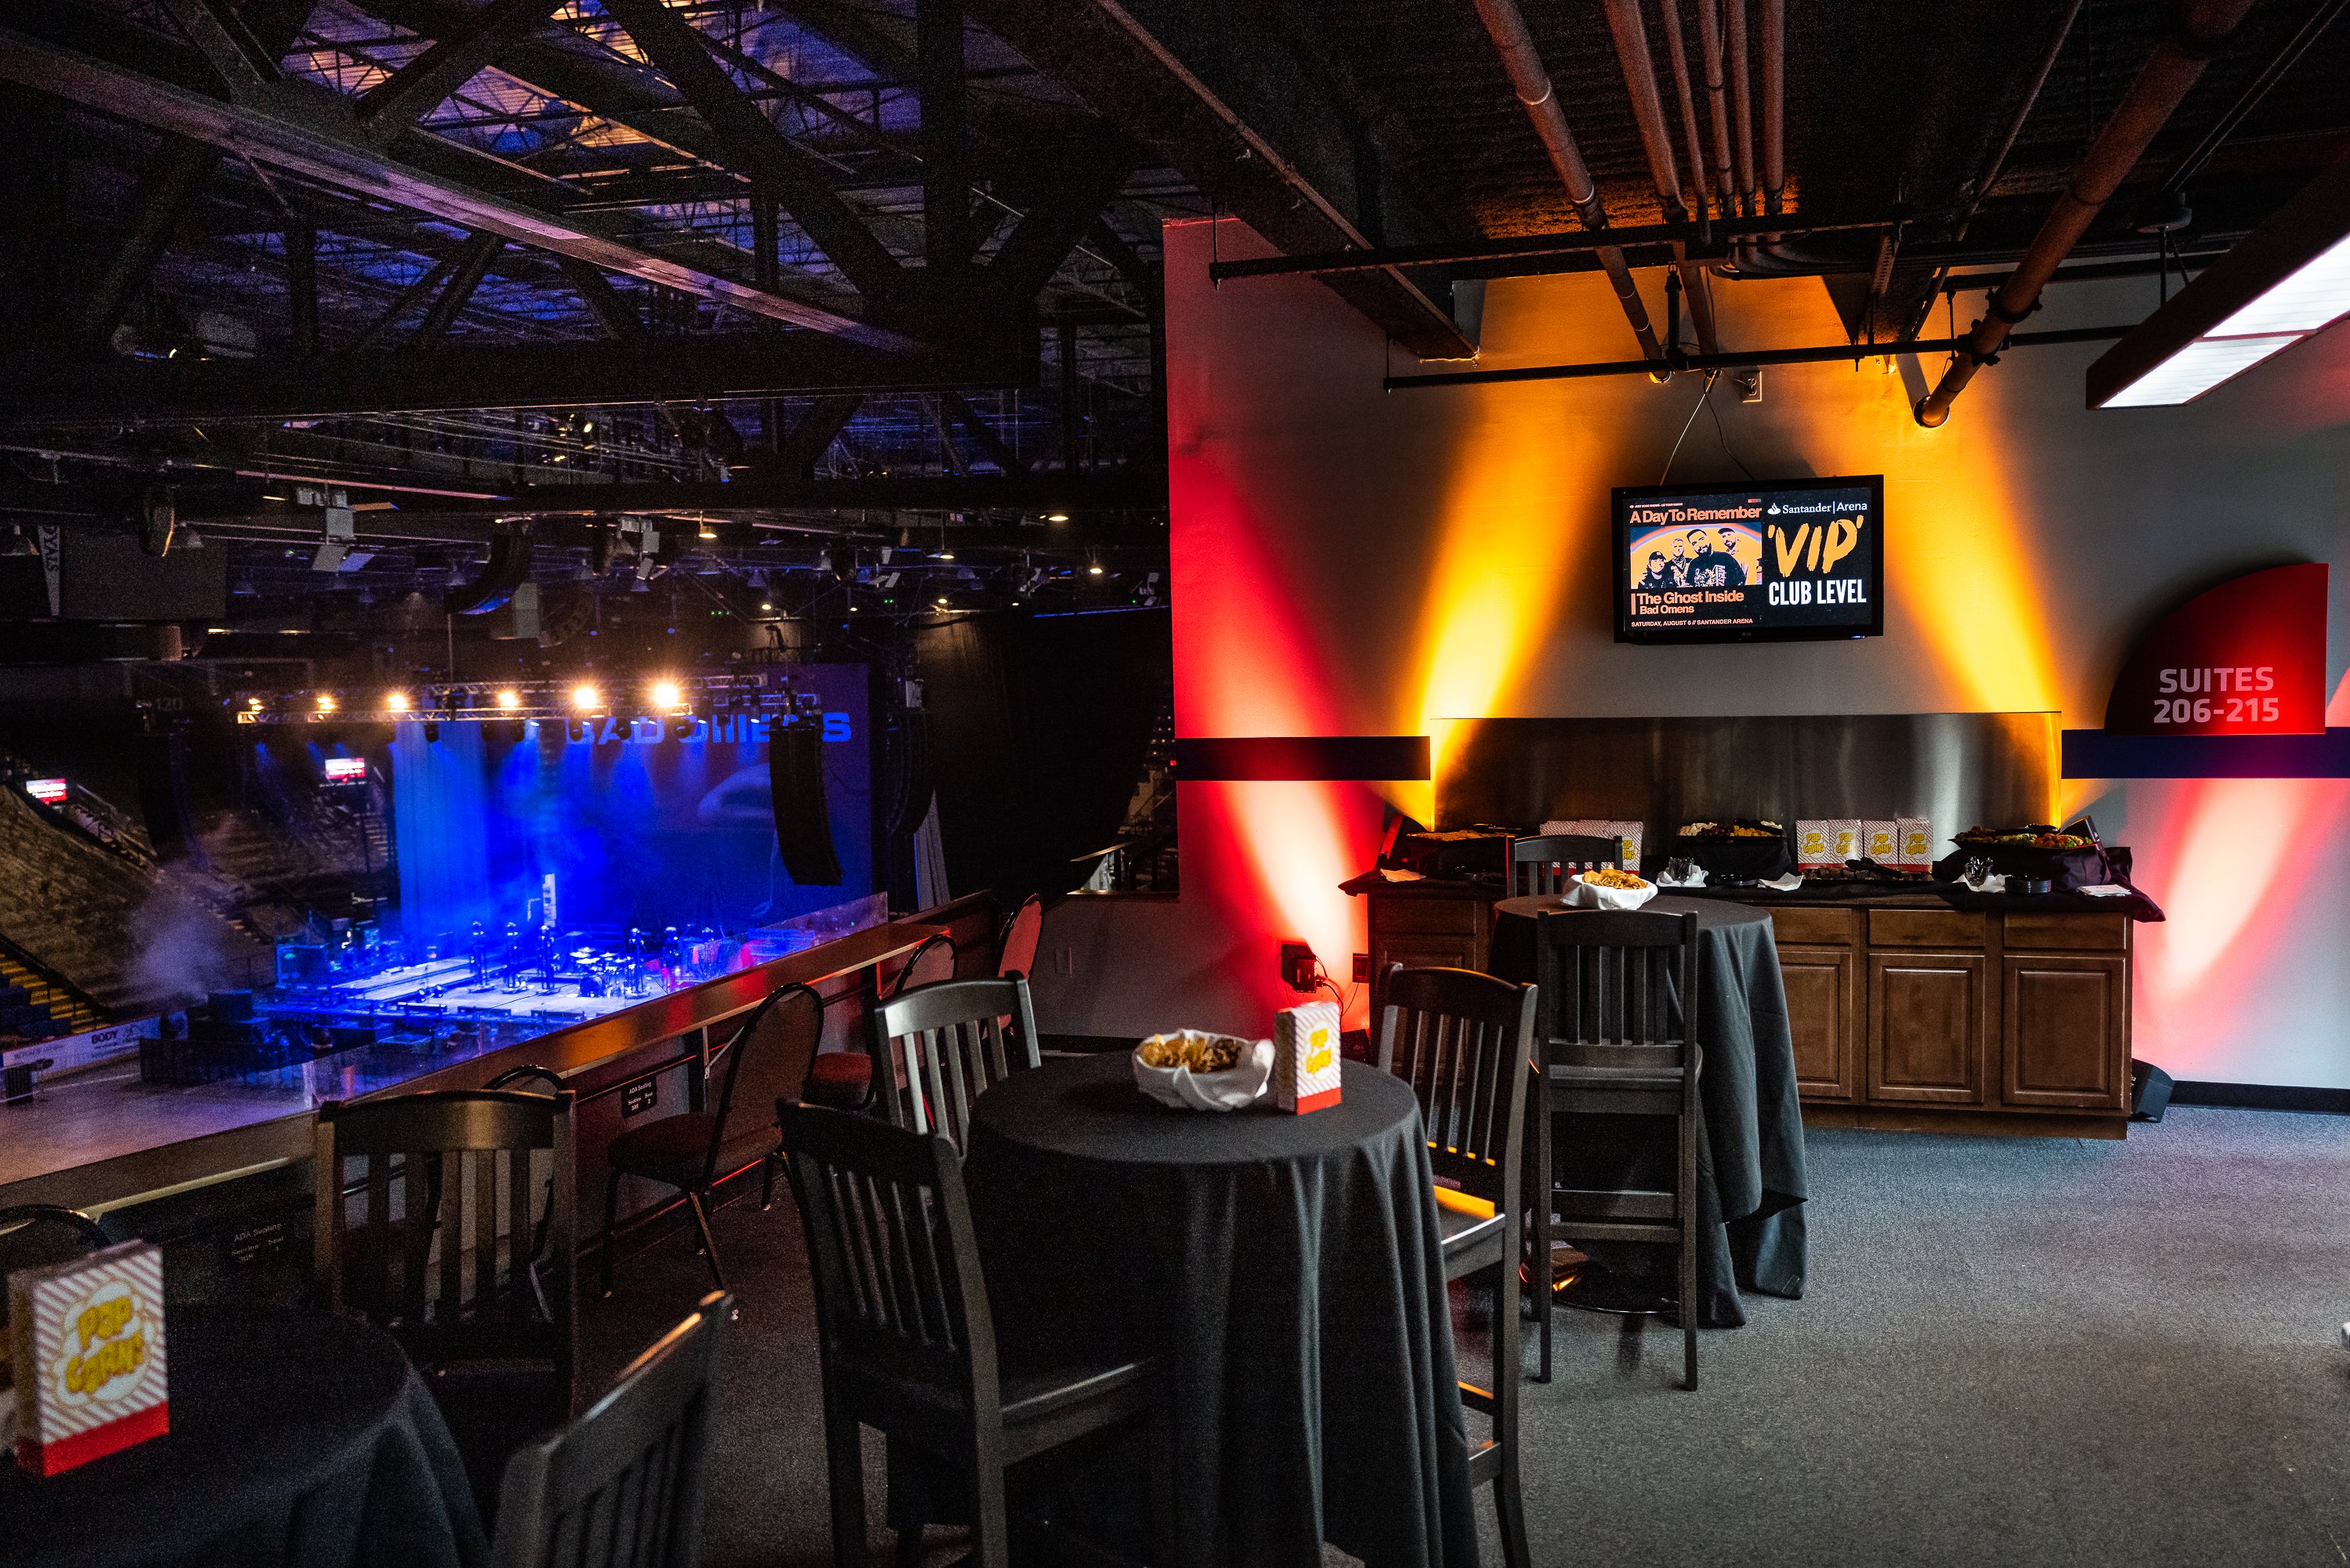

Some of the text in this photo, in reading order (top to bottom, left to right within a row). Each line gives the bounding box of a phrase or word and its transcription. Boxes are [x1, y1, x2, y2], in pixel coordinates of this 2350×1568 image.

[1782, 502, 1867, 514] Santander Arena
[1629, 506, 1762, 526] A Day To Remember
[1636, 590, 1744, 605] The Ghost Inside
[1769, 579, 1867, 606] CLUB LEVEL
[1640, 605, 1694, 615] Bad Omens
[2159, 667, 2274, 693] SUITES
[2153, 697, 2279, 723] 206-215
[1806, 833, 1821, 844] POP
[1839, 833, 1853, 844] POP
[1874, 833, 1889, 844] POP
[1910, 833, 1925, 844] POP
[92, 1029, 118, 1045] BODY
[234, 1230, 252, 1242] ADA
[78, 1296, 132, 1350] POP
